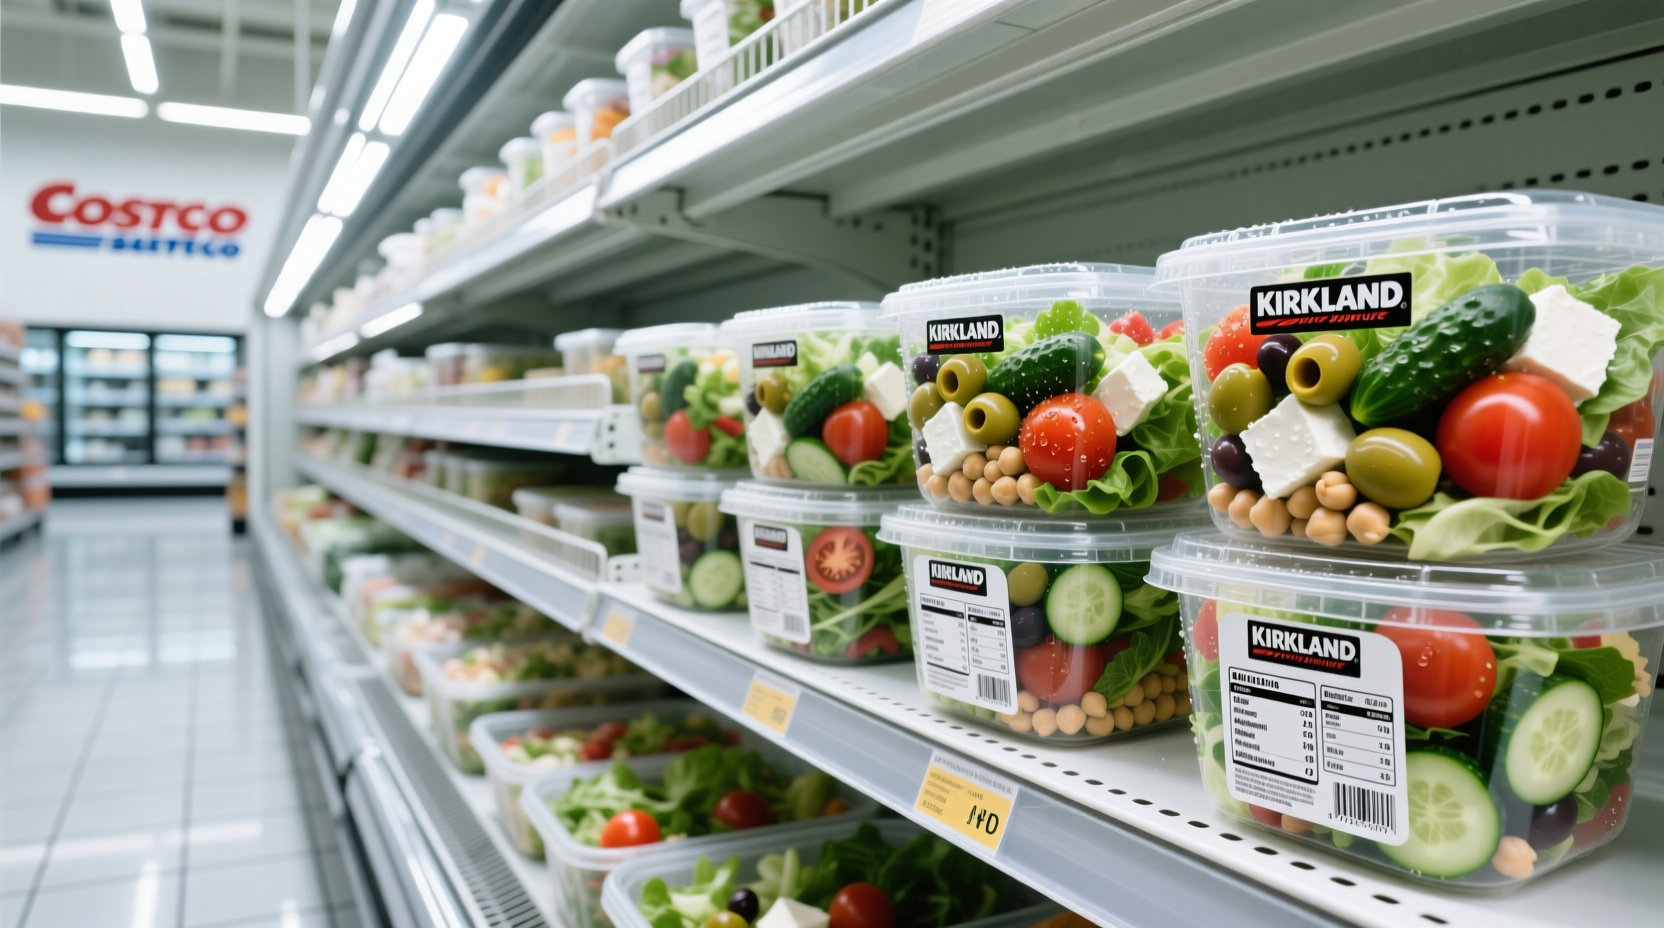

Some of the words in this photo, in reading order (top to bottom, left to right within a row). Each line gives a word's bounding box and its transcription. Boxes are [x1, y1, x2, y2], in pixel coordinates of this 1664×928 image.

[1256, 280, 1404, 317] KIRKLAND
[929, 320, 1000, 342] KIRKLAND
[1251, 625, 1356, 662] KIRKLAND
